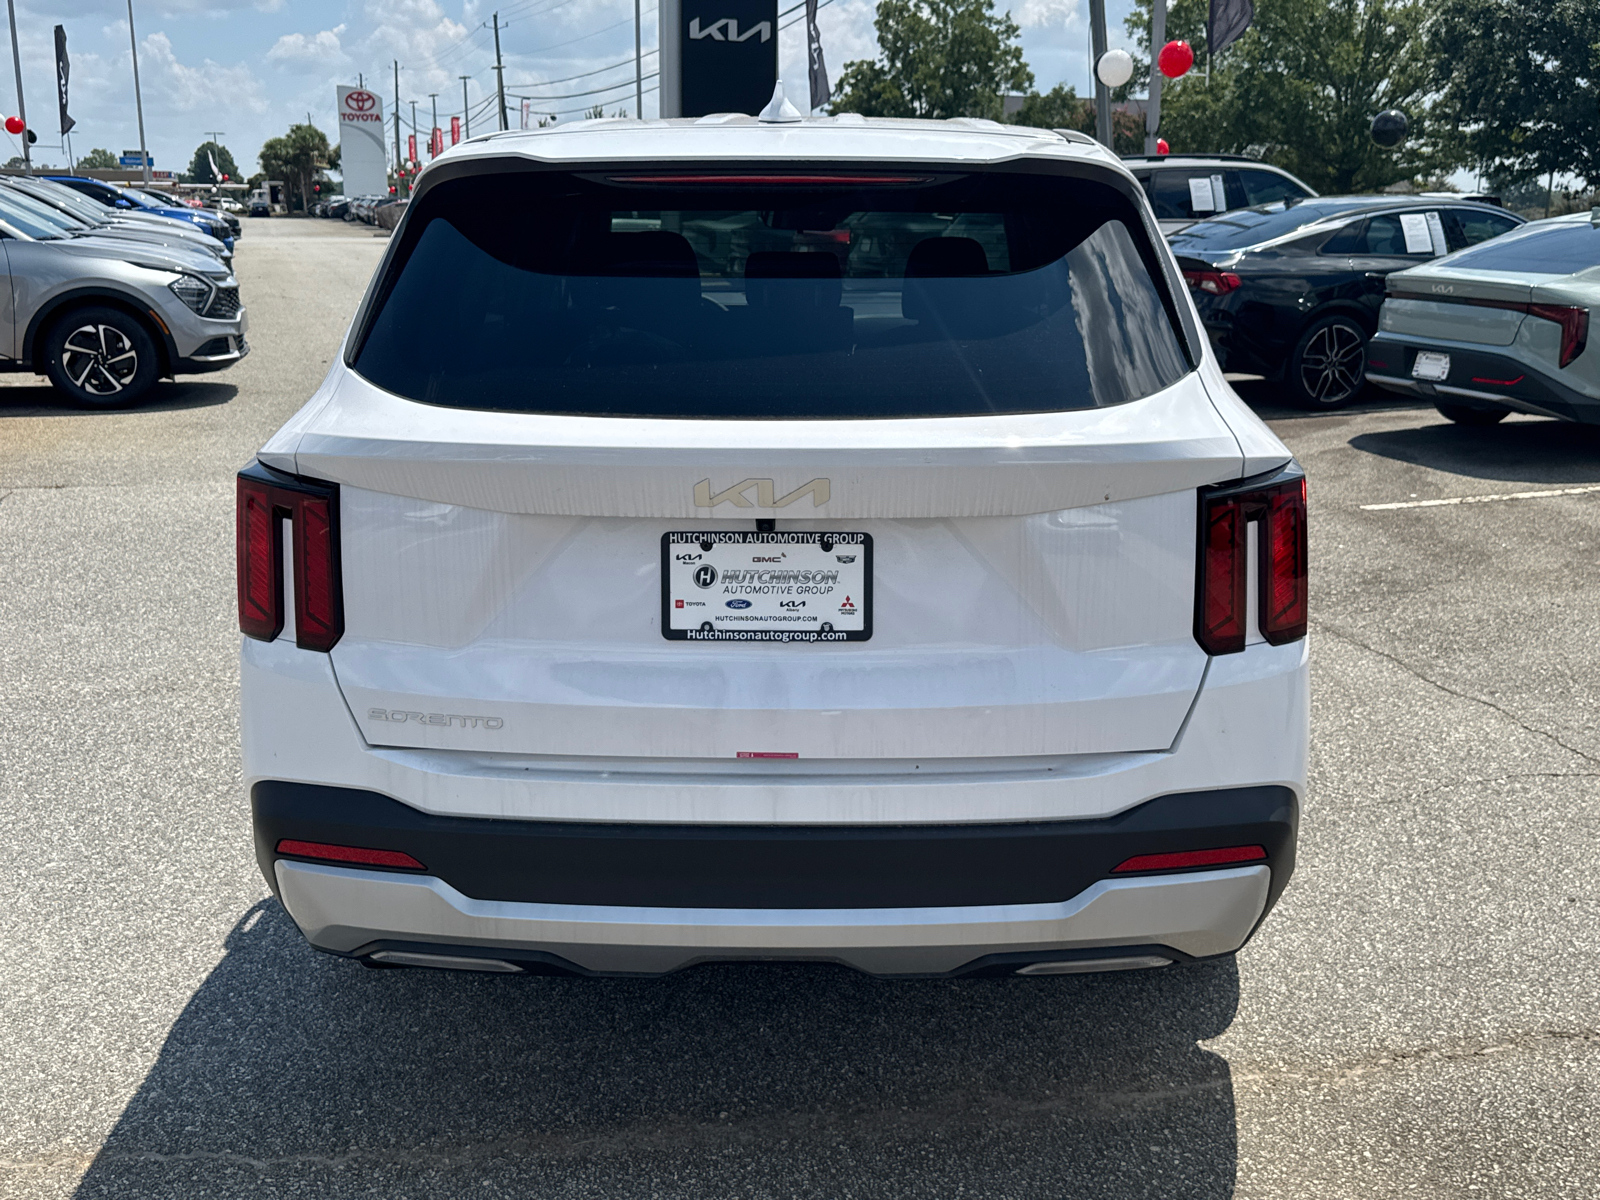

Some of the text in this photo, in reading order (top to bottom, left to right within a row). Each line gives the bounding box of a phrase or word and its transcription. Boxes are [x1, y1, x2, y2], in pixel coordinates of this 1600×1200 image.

[689, 17, 771, 43] KIA
[341, 112, 382, 122] TOYOTA
[1432, 284, 1454, 294] KIA
[693, 477, 831, 508] KIA
[669, 533, 865, 544] HUTCHINSON AUTOMOTIVE GROUP
[720, 570, 839, 584] HUTCHINSON
[722, 585, 834, 595] AUTOMOTIVE GROUP
[779, 600, 806, 608] KIA
[687, 629, 847, 642] Hutchinsonautogroup.com
[367, 707, 504, 730] SORENTO
